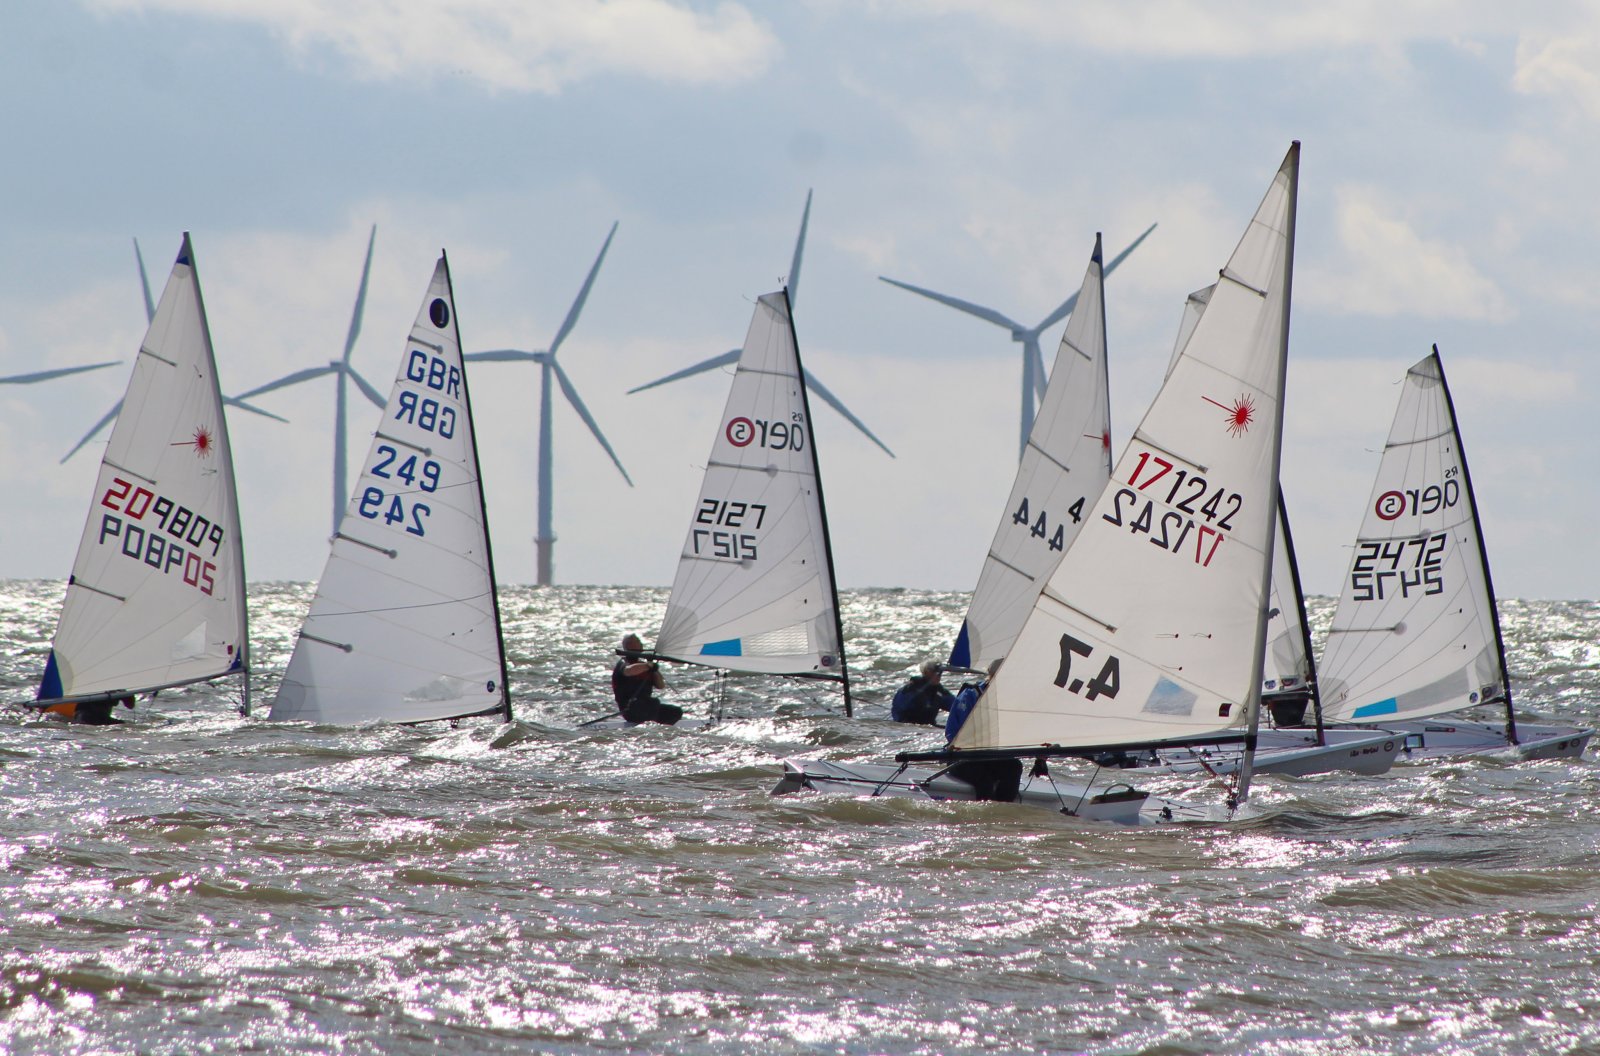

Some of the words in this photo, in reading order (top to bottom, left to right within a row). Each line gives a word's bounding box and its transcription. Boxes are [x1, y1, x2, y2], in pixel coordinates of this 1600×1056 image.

[407, 350, 461, 400] GBR
[371, 445, 442, 493] 249
[1127, 452, 1243, 531] 171242
[101, 477, 225, 557] 209809
[696, 499, 767, 530] 2127
[1353, 533, 1448, 572] 2472
